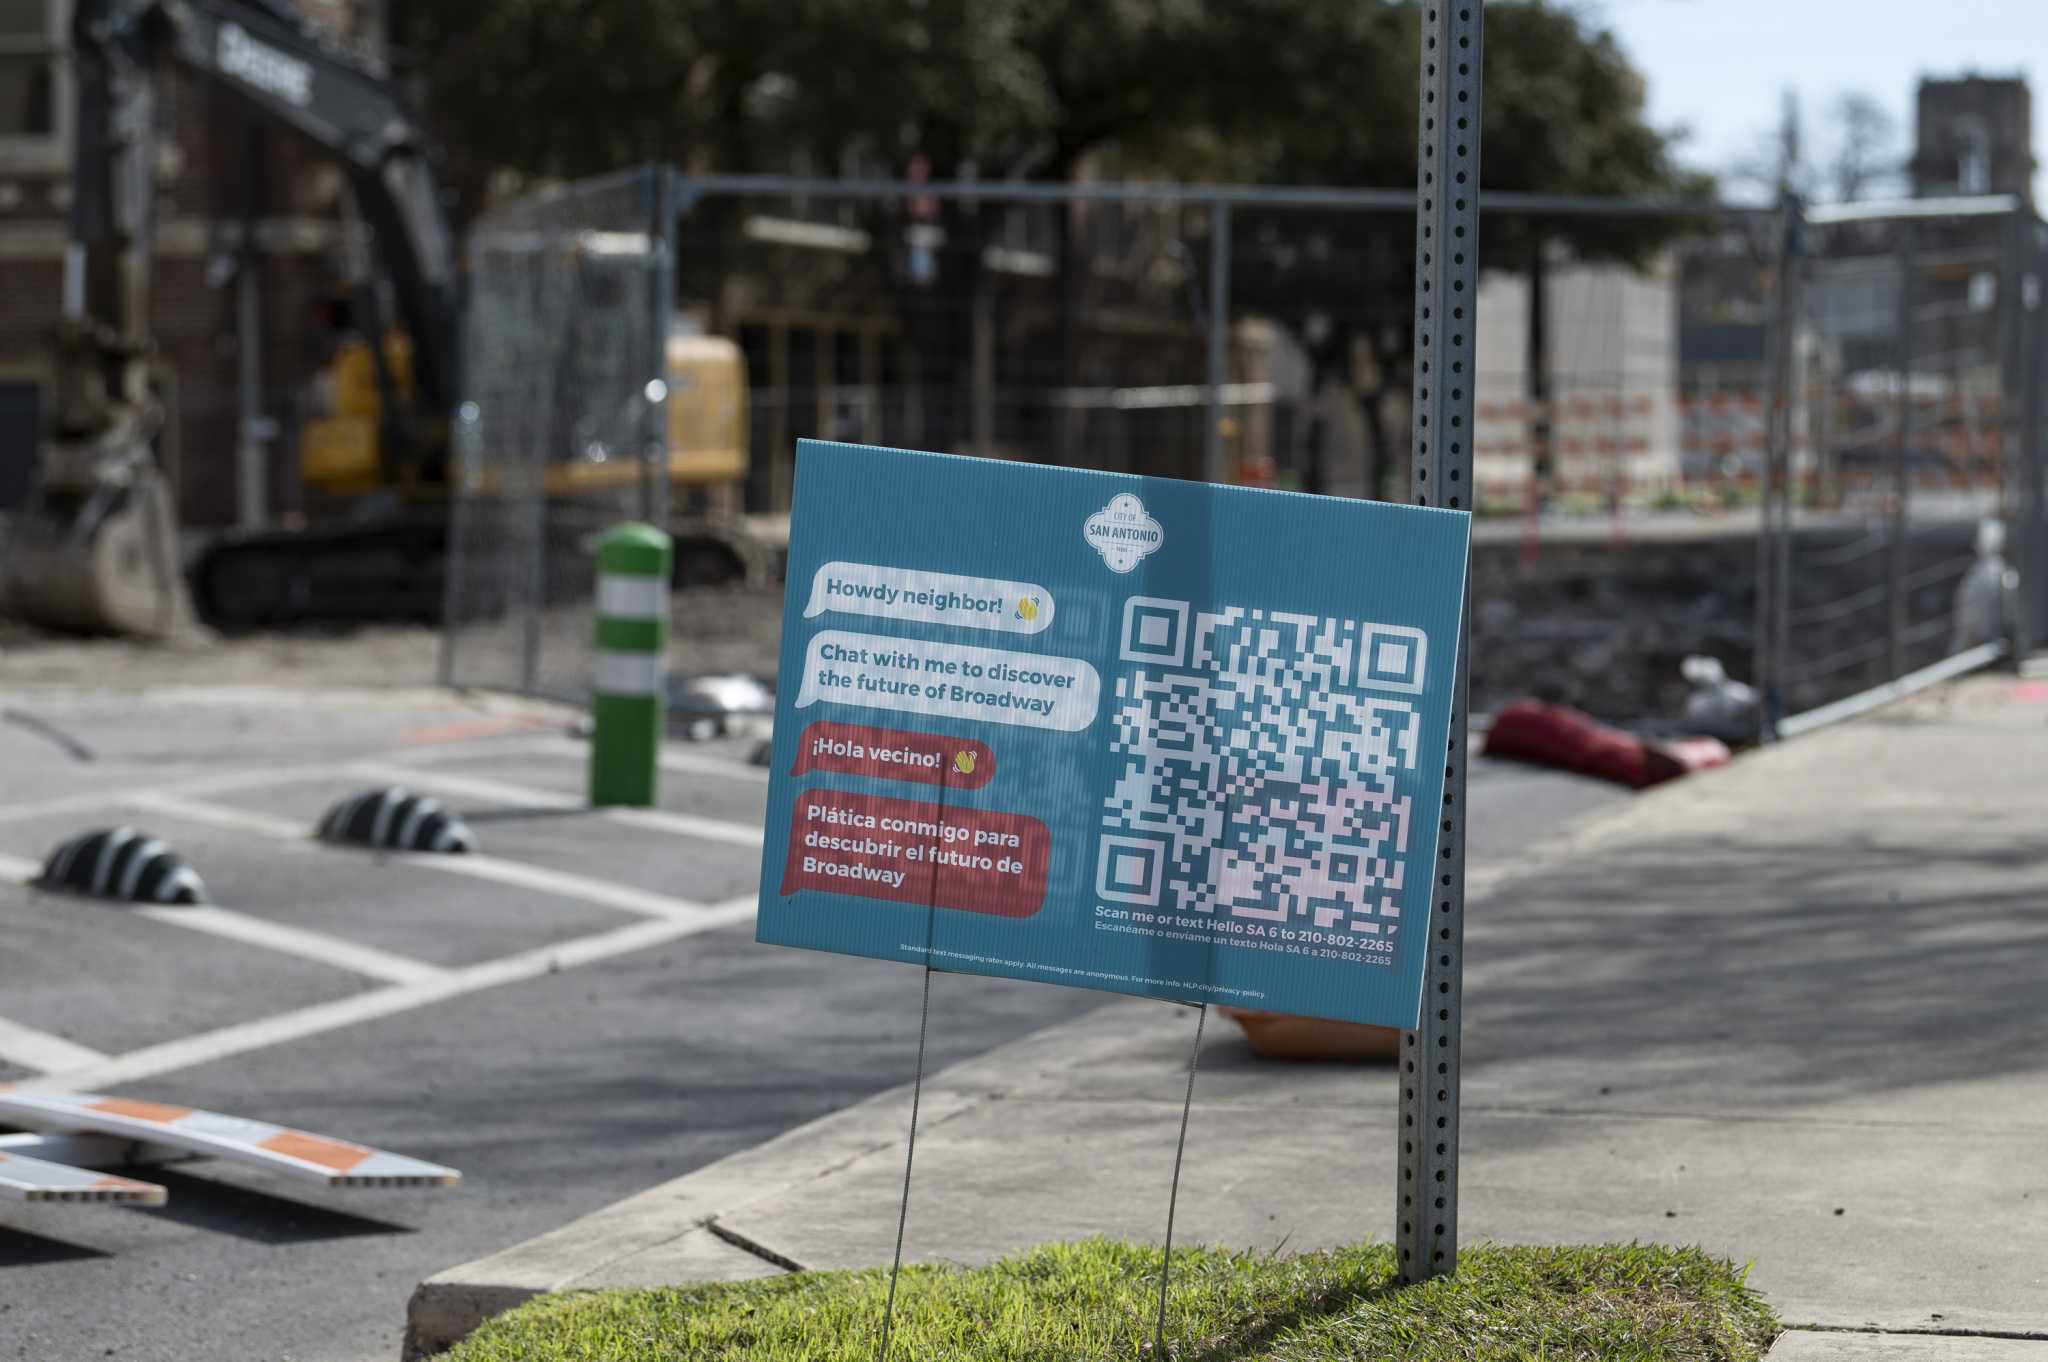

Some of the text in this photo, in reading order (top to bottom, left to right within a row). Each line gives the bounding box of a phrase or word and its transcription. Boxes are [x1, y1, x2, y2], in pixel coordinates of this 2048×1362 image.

[1089, 524, 1158, 542] SAN ANTONIO
[827, 578, 1002, 613] Howdy neighbor!
[820, 643, 1075, 688] Chat with me to discover
[818, 670, 1055, 716] the future of Broadway
[813, 738, 941, 768] ¡Hola vecino!
[807, 804, 1020, 848] Plática conmigo para
[803, 856, 905, 888] Broadway
[804, 831, 1024, 874] descubrir el futuro de
[1095, 905, 1394, 952] Scan me or text Hello SA 6 to 210-802-2265
[1157, 929, 1164, 937] o
[1213, 937, 1227, 946] un
[1229, 938, 1257, 949] texto
[1259, 941, 1283, 952] Hola
[1286, 944, 1300, 954] SA
[1303, 947, 1309, 955] 6
[1320, 949, 1391, 966] 210-802-2265
